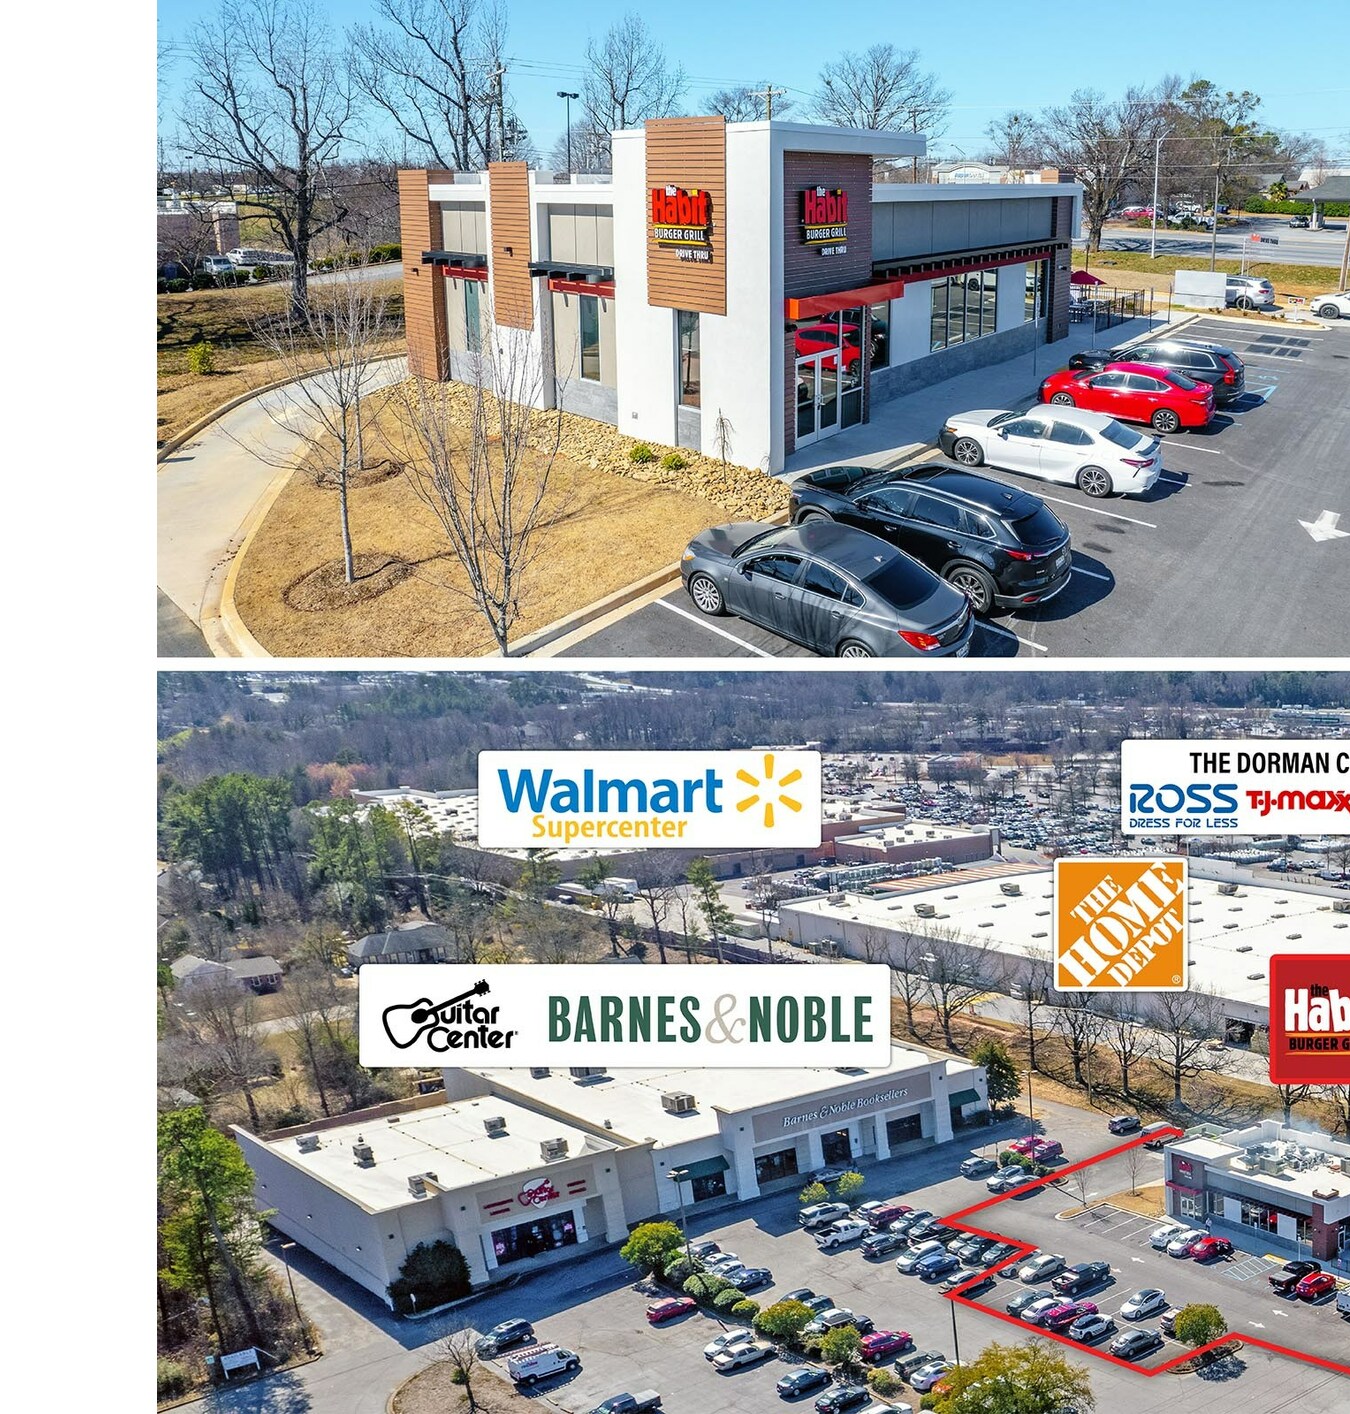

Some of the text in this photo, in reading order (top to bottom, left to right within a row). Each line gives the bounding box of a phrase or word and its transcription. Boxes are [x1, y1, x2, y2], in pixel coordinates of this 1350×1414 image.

[652, 188, 707, 225] Habit
[804, 188, 848, 224] Habit
[654, 228, 705, 241] BURGER GRILL
[806, 227, 847, 240] BURGER GRILL
[675, 249, 709, 260] DRIVE THRU
[821, 245, 847, 256] DRIVE THRU
[783, 1088, 908, 1127] Barnes & Noble Booksellers
